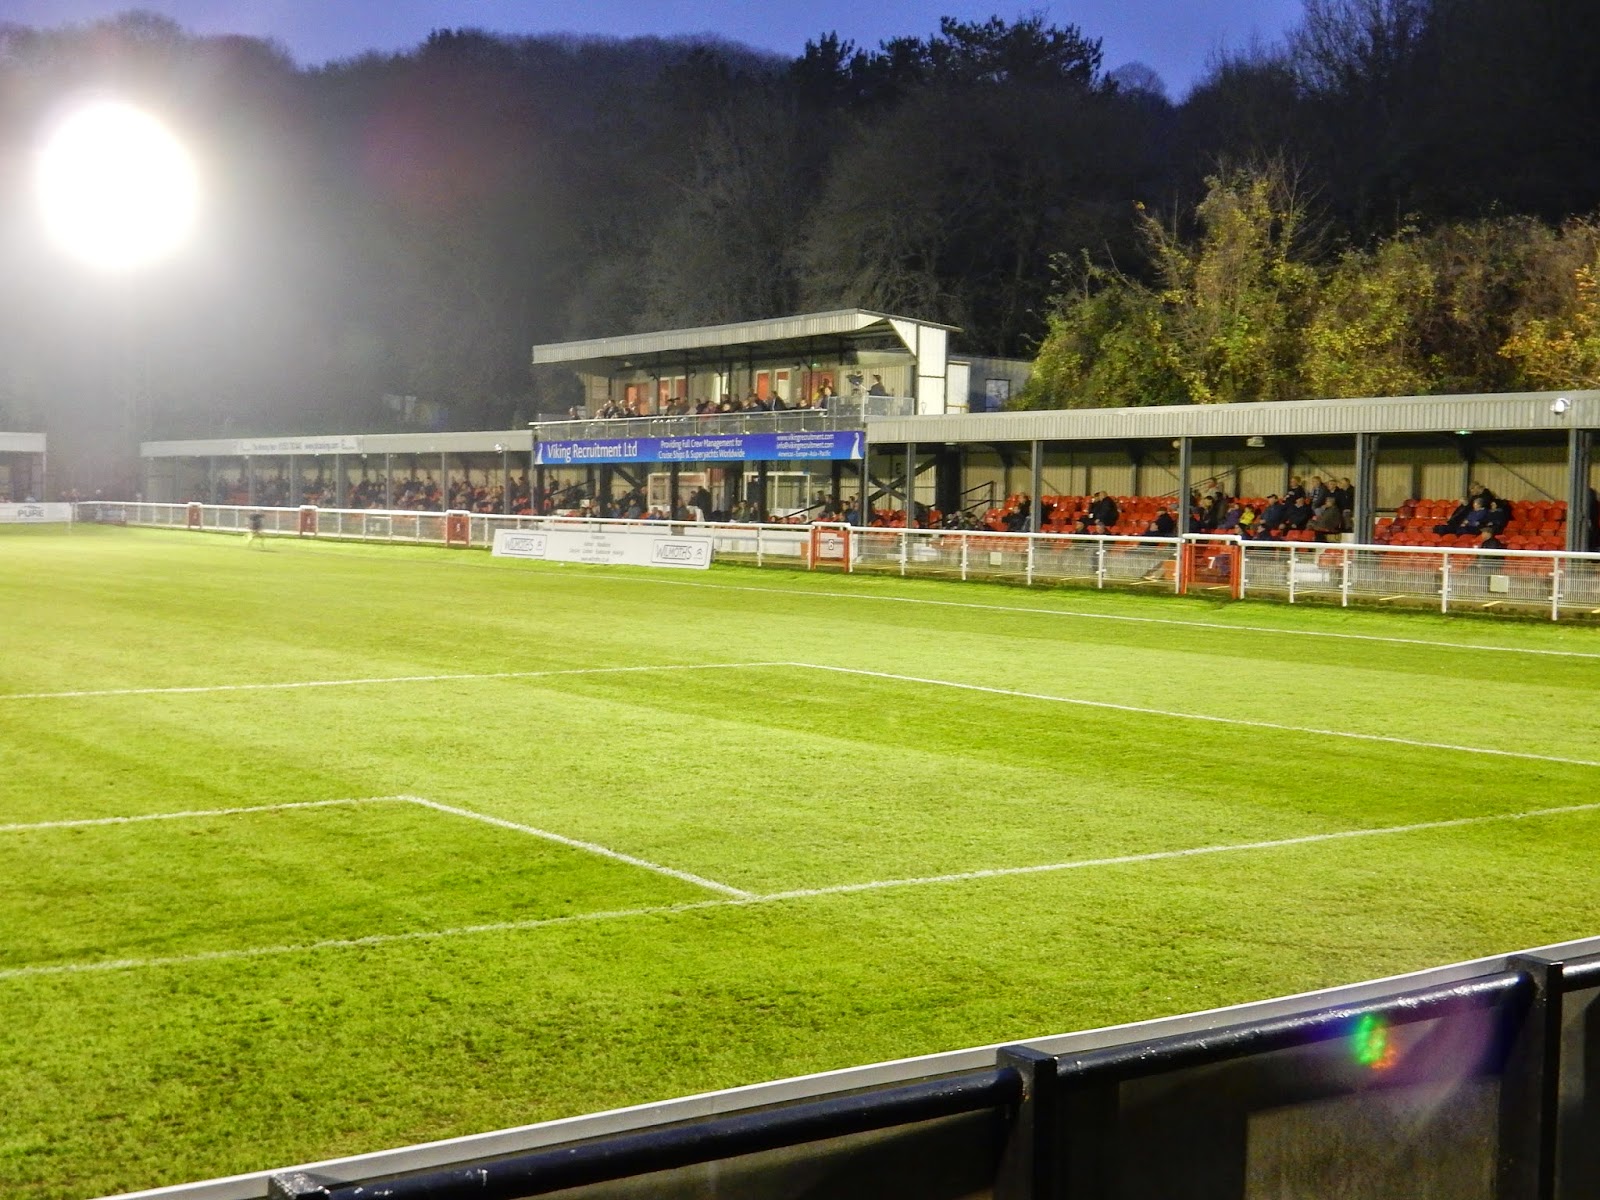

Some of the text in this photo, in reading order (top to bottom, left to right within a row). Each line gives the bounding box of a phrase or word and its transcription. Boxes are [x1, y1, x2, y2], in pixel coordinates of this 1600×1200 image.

[682, 439, 690, 448] Full
[704, 438, 734, 449] Management
[735, 437, 743, 447] for
[547, 441, 638, 462] Viking Recruitment Ltd
[829, 539, 835, 551] 6
[1207, 556, 1216, 569] 7
